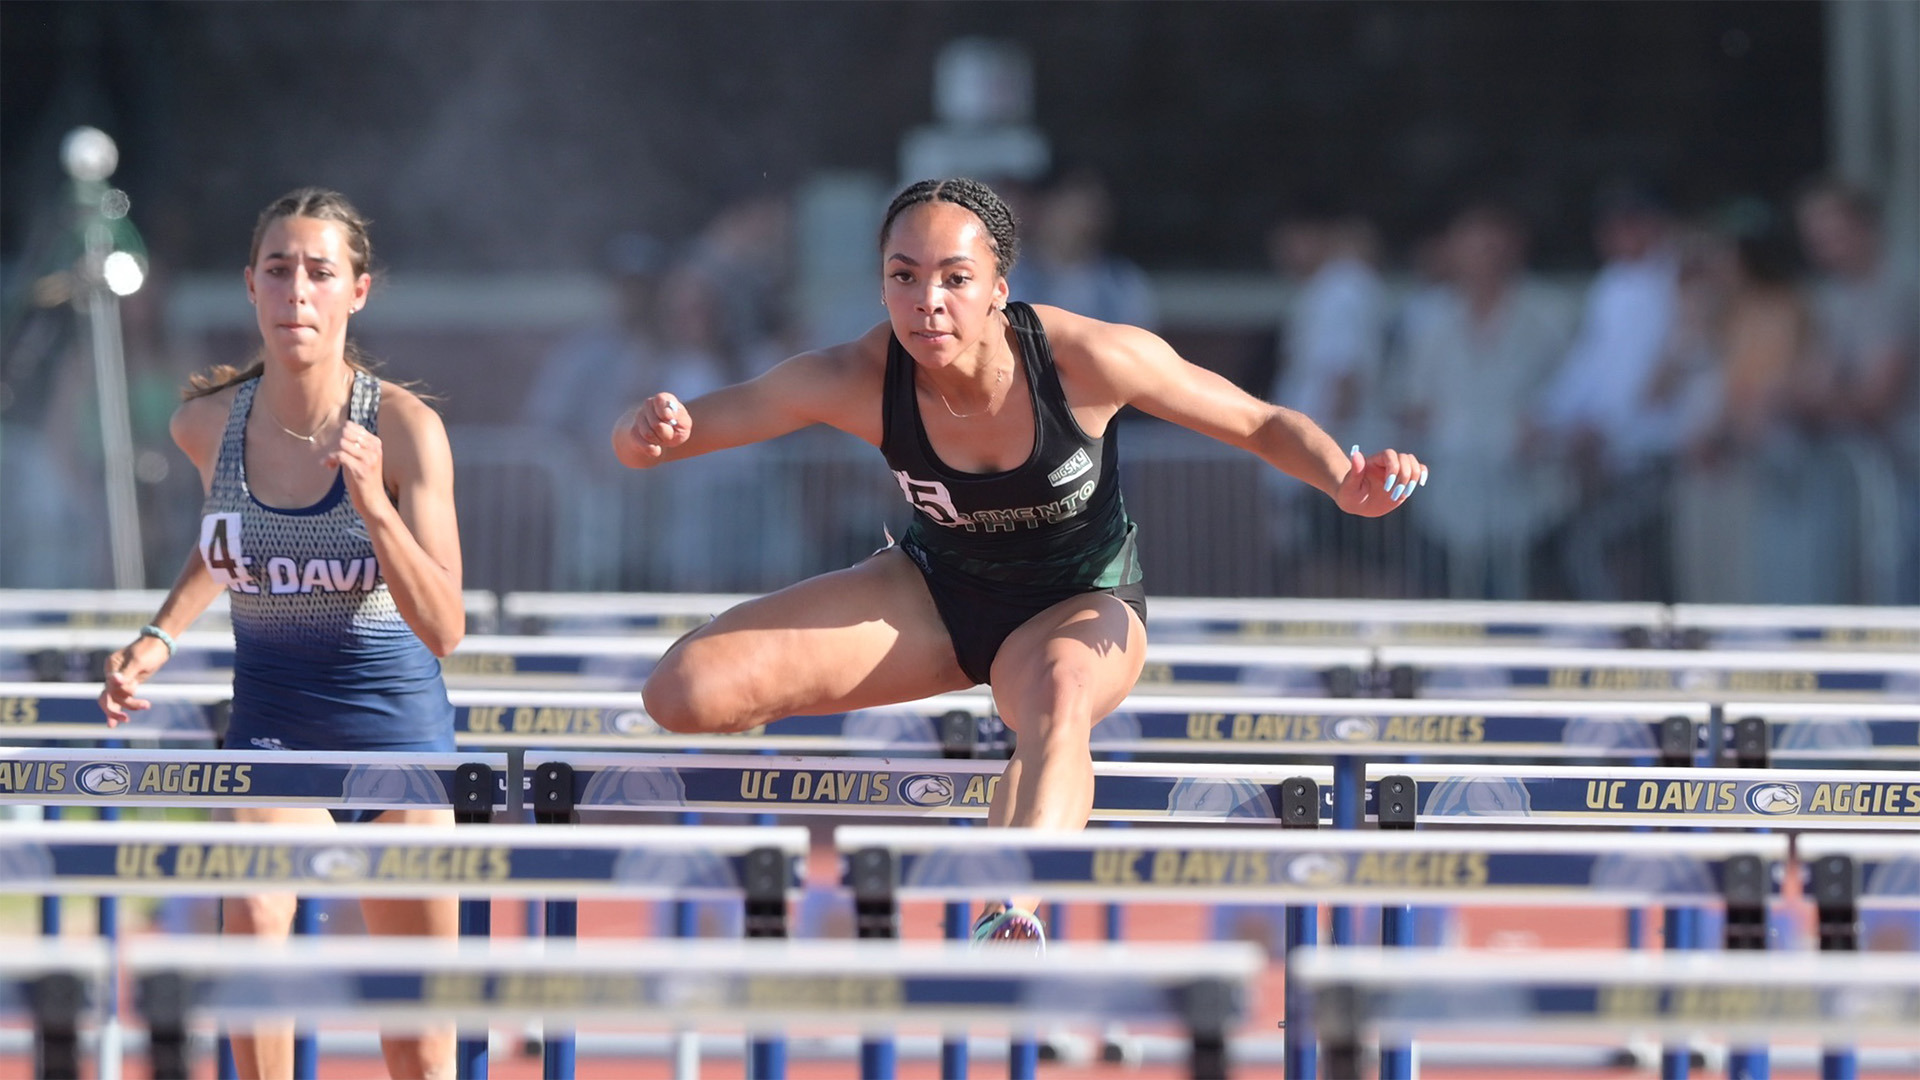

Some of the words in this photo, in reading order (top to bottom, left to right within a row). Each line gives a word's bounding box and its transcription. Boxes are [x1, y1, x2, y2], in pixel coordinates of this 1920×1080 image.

[906, 481, 957, 524] 5
[208, 518, 238, 580] 4
[266, 556, 378, 595] DAVI
[467, 706, 508, 733] UC
[512, 706, 600, 734] DAVIS
[1185, 713, 1226, 740] UC
[1232, 713, 1322, 741] DAVIS
[1382, 715, 1486, 742] AGGIES
[0, 762, 66, 791] AVIS
[137, 763, 252, 793] AGGIES
[739, 770, 780, 800] UC
[790, 771, 890, 802] DAVIS
[1585, 780, 1627, 810] UC
[1637, 781, 1737, 811] DAVIS
[1808, 783, 1920, 814] AGGIES
[115, 844, 165, 879] UC
[175, 844, 293, 880] DAVIS
